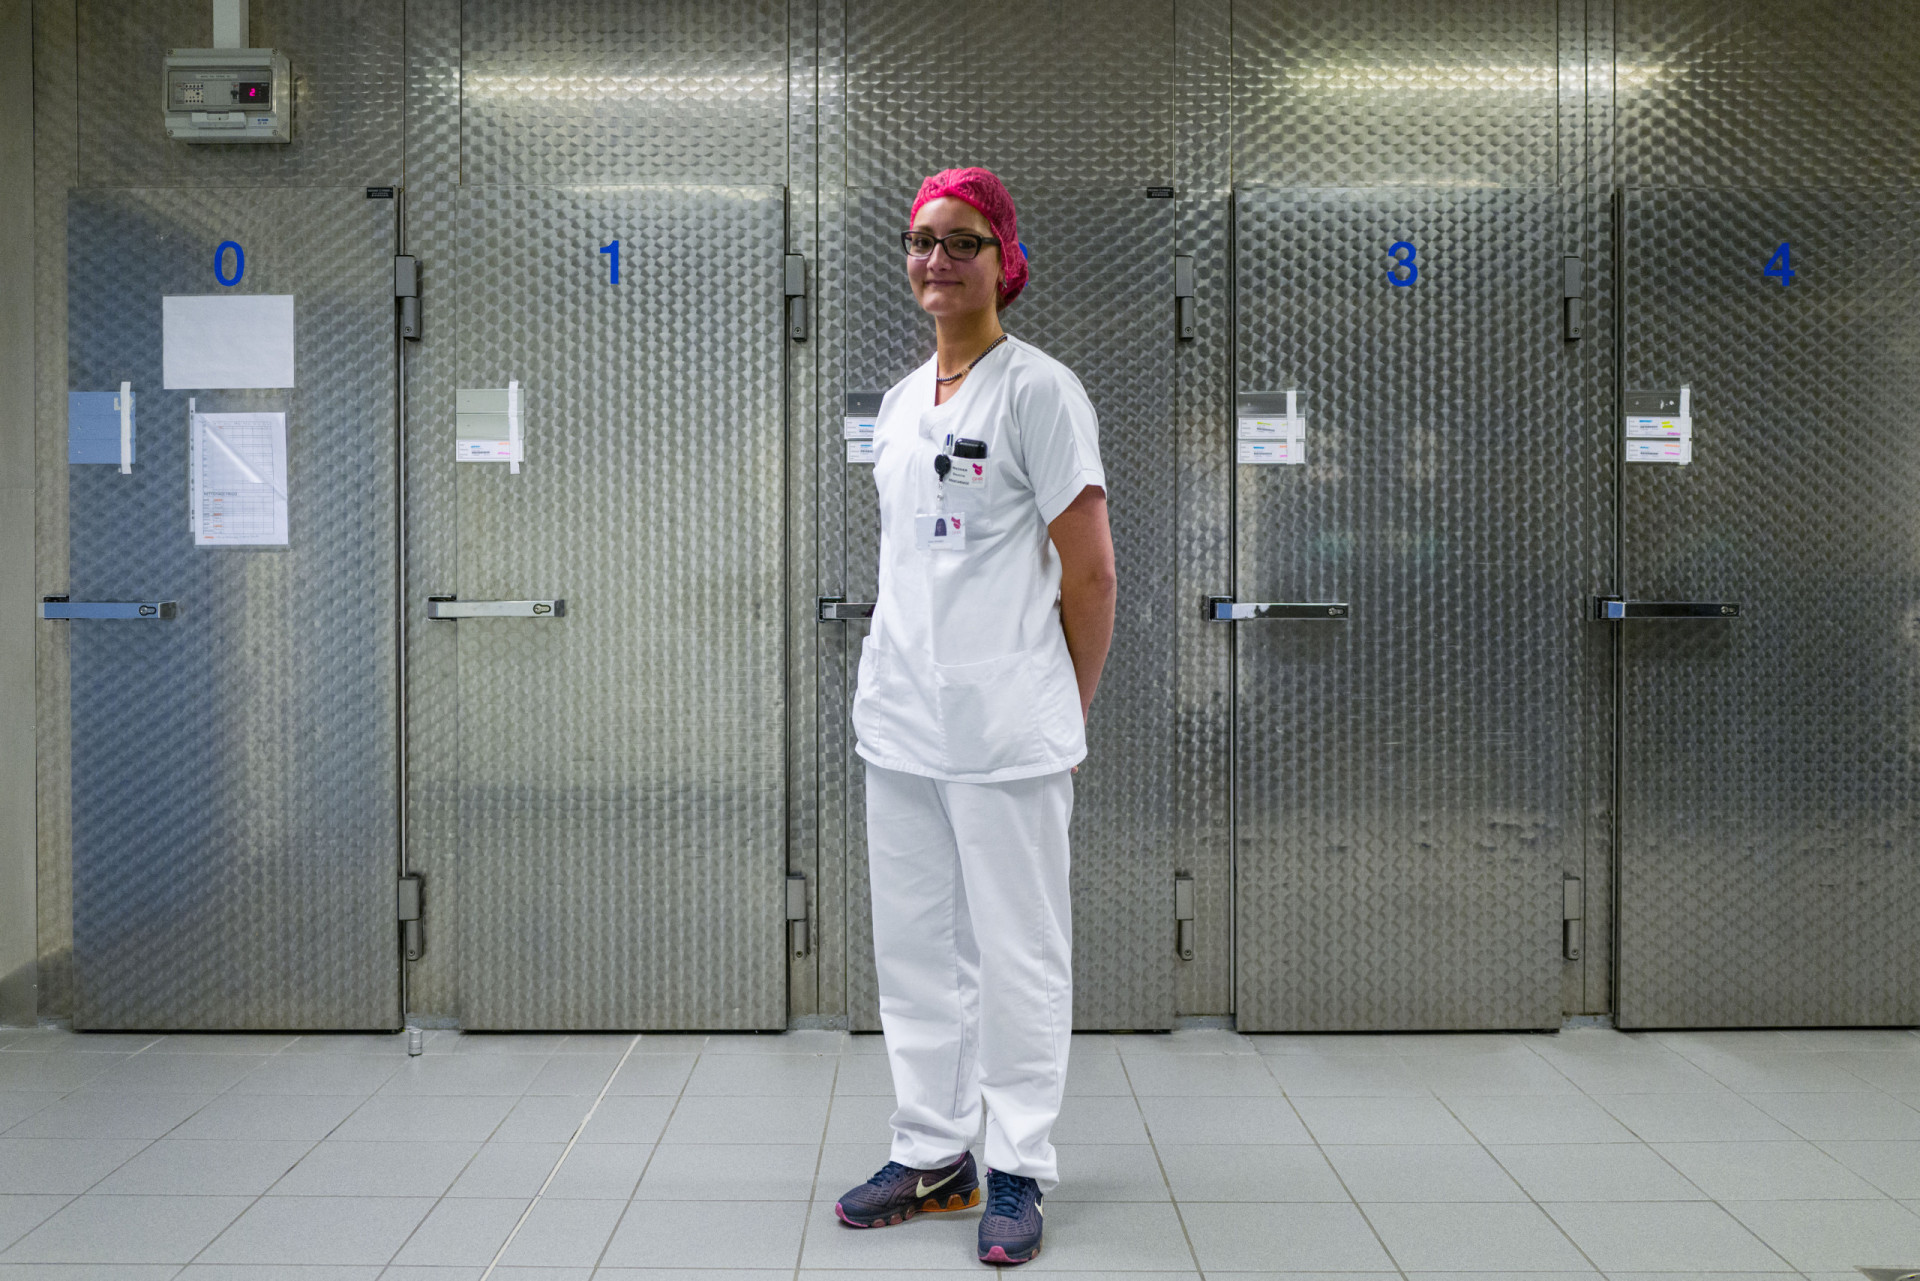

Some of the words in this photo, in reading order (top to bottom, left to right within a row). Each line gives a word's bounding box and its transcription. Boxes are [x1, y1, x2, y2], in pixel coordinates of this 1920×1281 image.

[249, 88, 256, 97] 2
[213, 241, 245, 287] 0
[599, 240, 620, 285] 1
[1386, 241, 1419, 288] 3
[1763, 243, 1796, 287] 4
